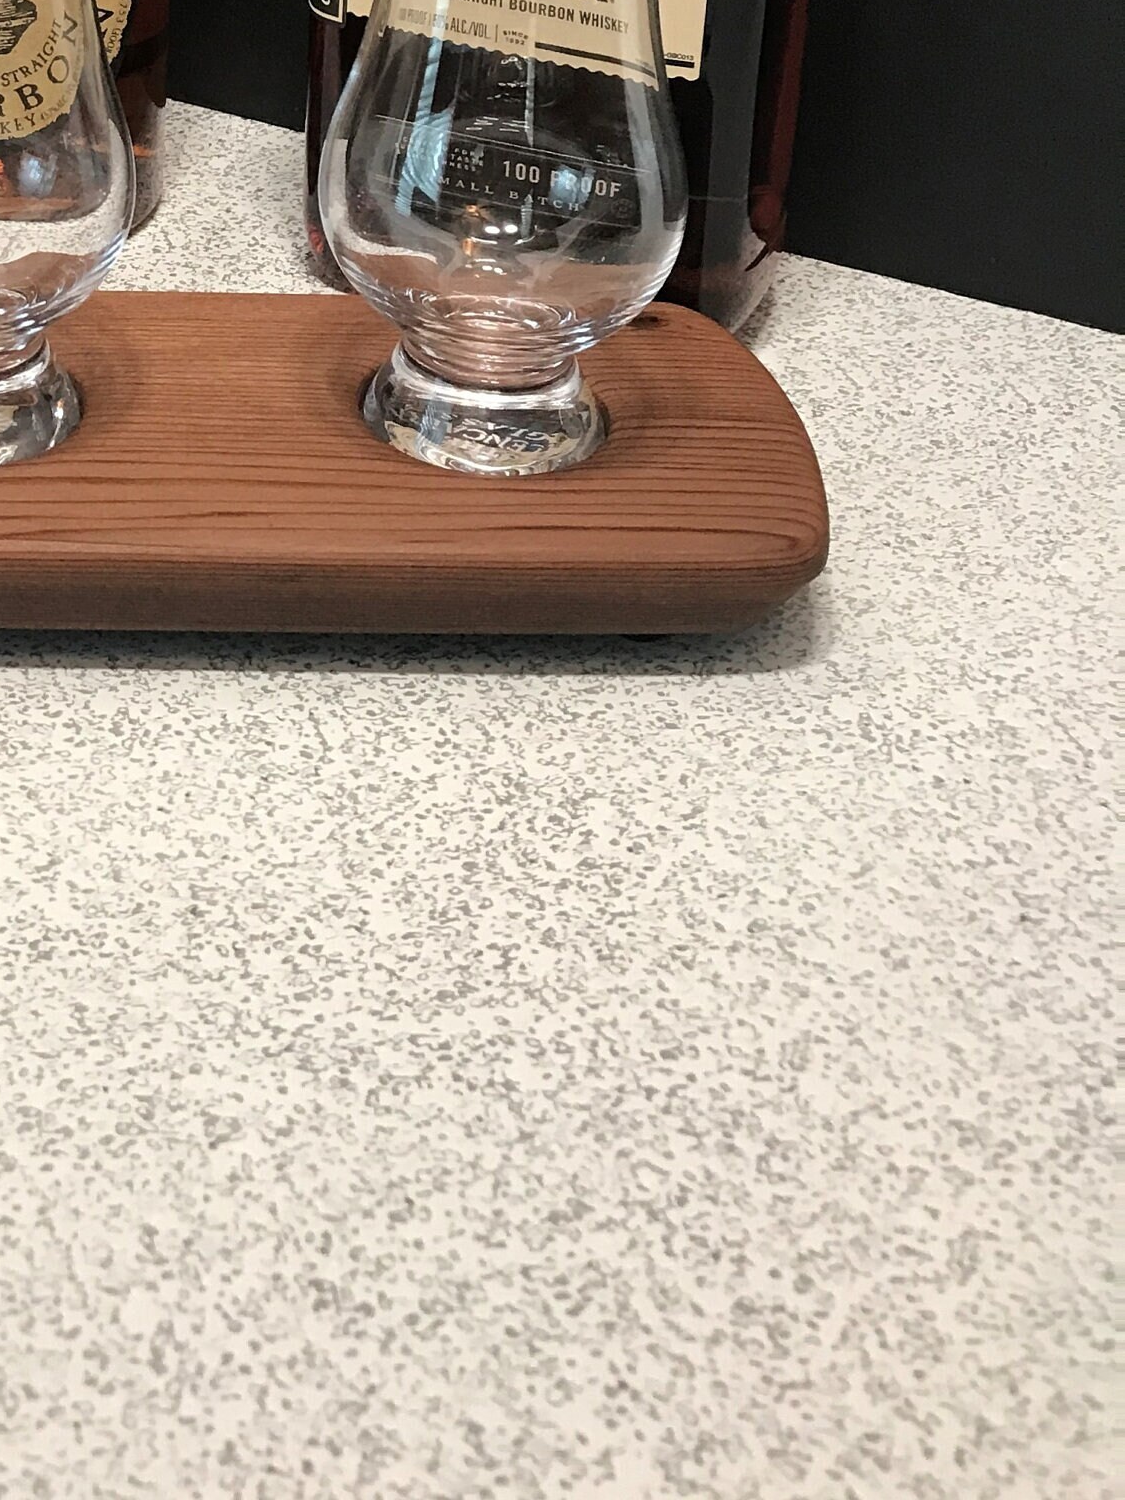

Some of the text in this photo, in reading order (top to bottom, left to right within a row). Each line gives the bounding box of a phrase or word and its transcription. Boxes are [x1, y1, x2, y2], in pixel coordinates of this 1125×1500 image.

[578, 10, 629, 34] WHISKEY
[1, 19, 62, 87] STRAIGHT
[502, 160, 623, 198] 100 PROOF
[508, 190, 580, 212] BATCH
